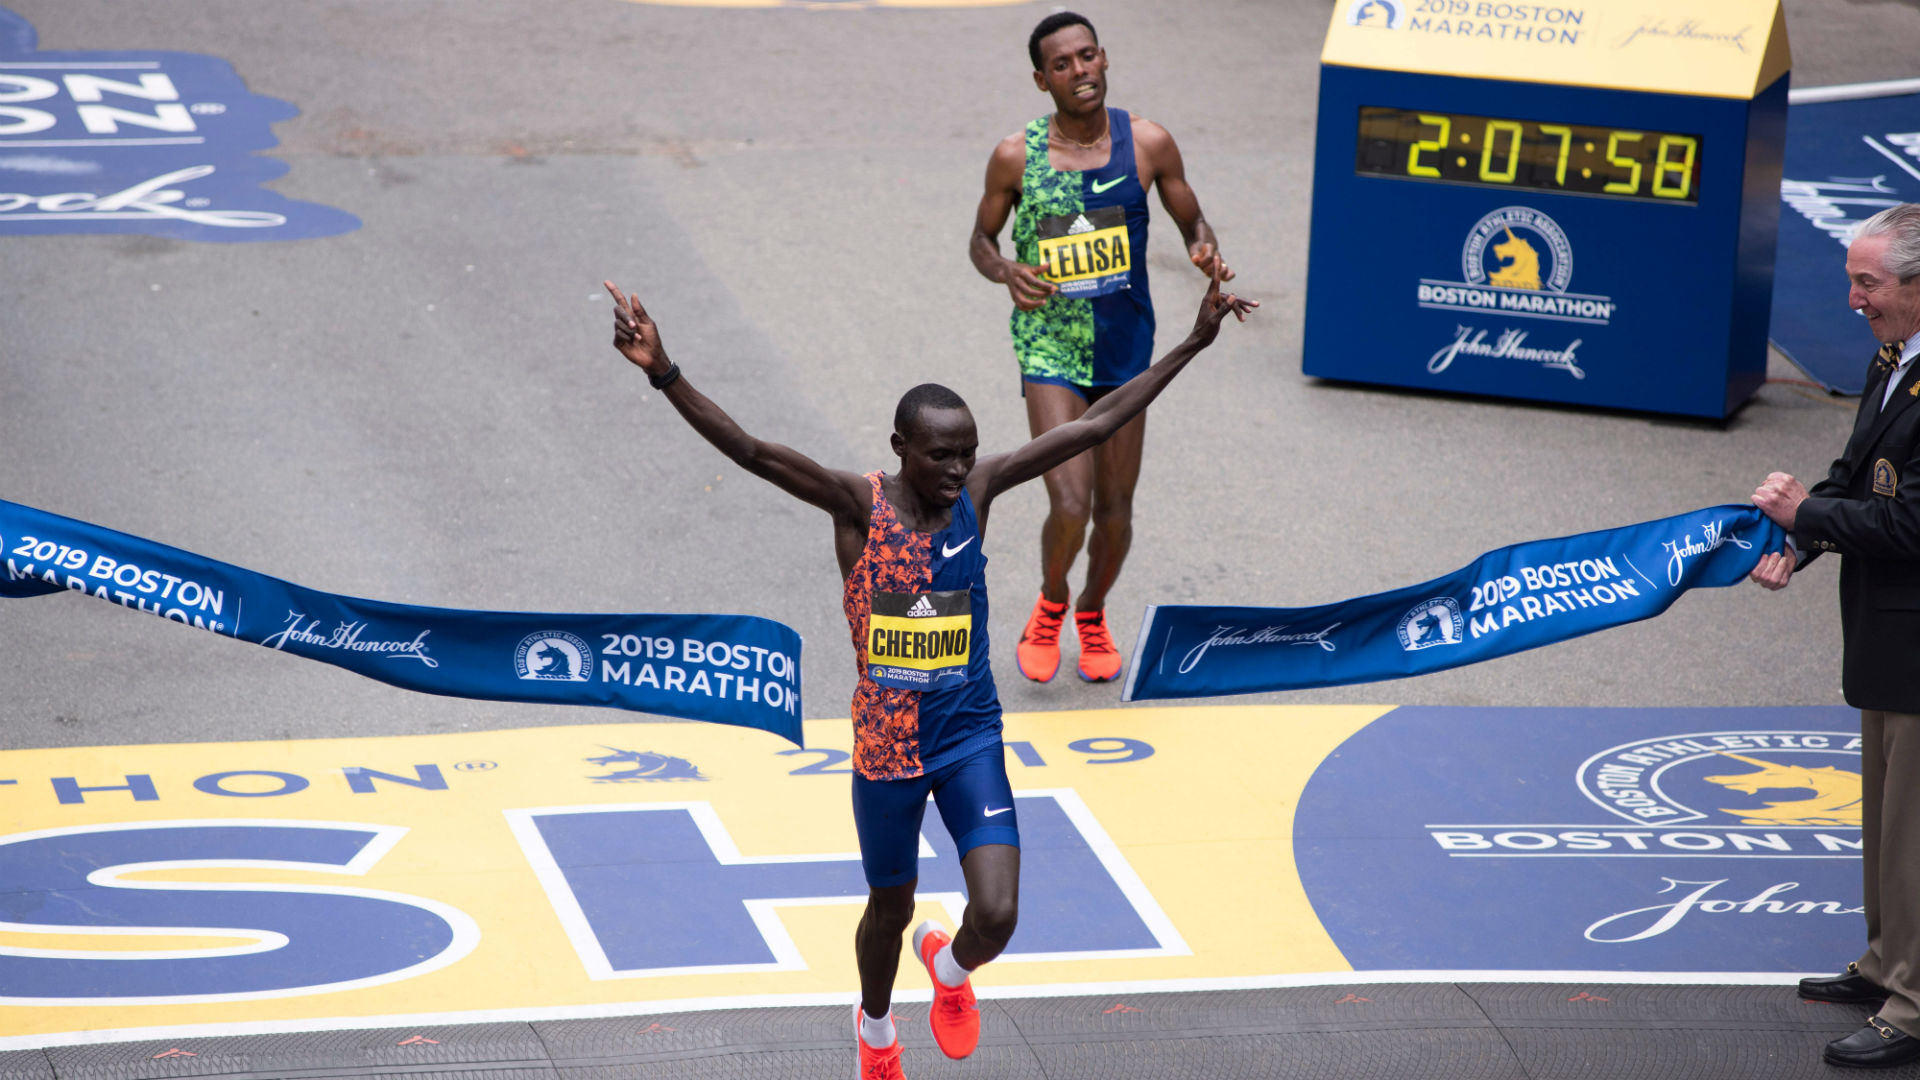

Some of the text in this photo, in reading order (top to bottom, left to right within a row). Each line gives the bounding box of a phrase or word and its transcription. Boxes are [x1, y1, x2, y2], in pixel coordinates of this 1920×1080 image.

[1409, 17, 1579, 45] MARATHON
[1416, 0, 1584, 25] 2019 BOSTON
[1407, 114, 1697, 199] 2:07:58
[1043, 235, 1126, 279] LELISA
[1418, 285, 1611, 319] BOSTON MARATHON
[1427, 324, 1586, 379] John Hancock
[12, 536, 224, 616] 2019 BOSTON
[1661, 533, 1705, 587] John
[1469, 556, 1621, 613] 2019 BOSTON
[907, 609, 937, 617] adidas
[1469, 580, 1641, 640] MARATHON
[260, 609, 439, 668] John Hancock
[517, 645, 529, 674] BOSTON
[524, 632, 562, 647] ATHLETIC
[601, 633, 795, 686] 2019 BOSTON
[872, 628, 968, 660] CHERONO
[1178, 622, 1342, 674] John Hancock
[601, 660, 795, 717] MARATHON
[887, 673, 930, 684] MARATHON
[902, 669, 929, 678] BOSTON
[775, 737, 1155, 776] 219
[1597, 735, 1830, 818] BOSTON ATHLETIC
[0, 763, 449, 805] HON
[1430, 832, 1793, 851] BOSTON
[1584, 877, 1850, 943] John
